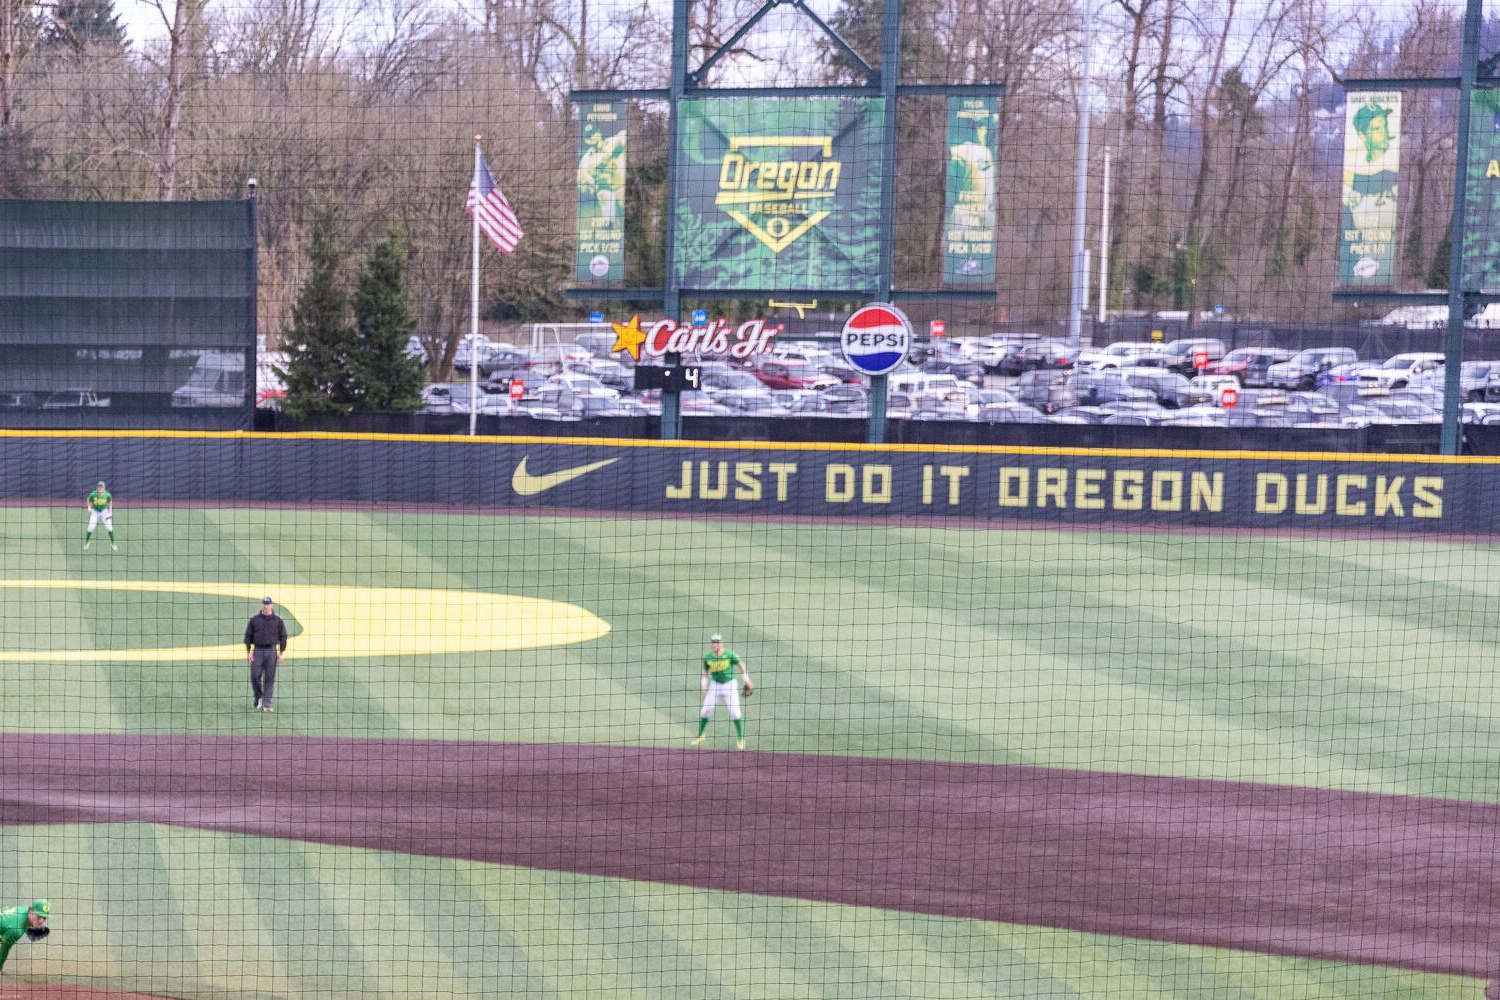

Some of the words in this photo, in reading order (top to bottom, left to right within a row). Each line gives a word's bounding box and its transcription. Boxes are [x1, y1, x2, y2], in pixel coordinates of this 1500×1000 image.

[716, 153, 842, 199] Oregon
[1486, 160, 1500, 177] A
[749, 203, 809, 215] BASEBALL
[645, 320, 731, 357] Carl's
[847, 334, 904, 346] PEPSI
[666, 460, 797, 501] JUST
[826, 463, 892, 503] DO
[922, 465, 970, 504] IT
[999, 466, 1224, 512] OREGON
[1255, 472, 1443, 518] DUCKS
